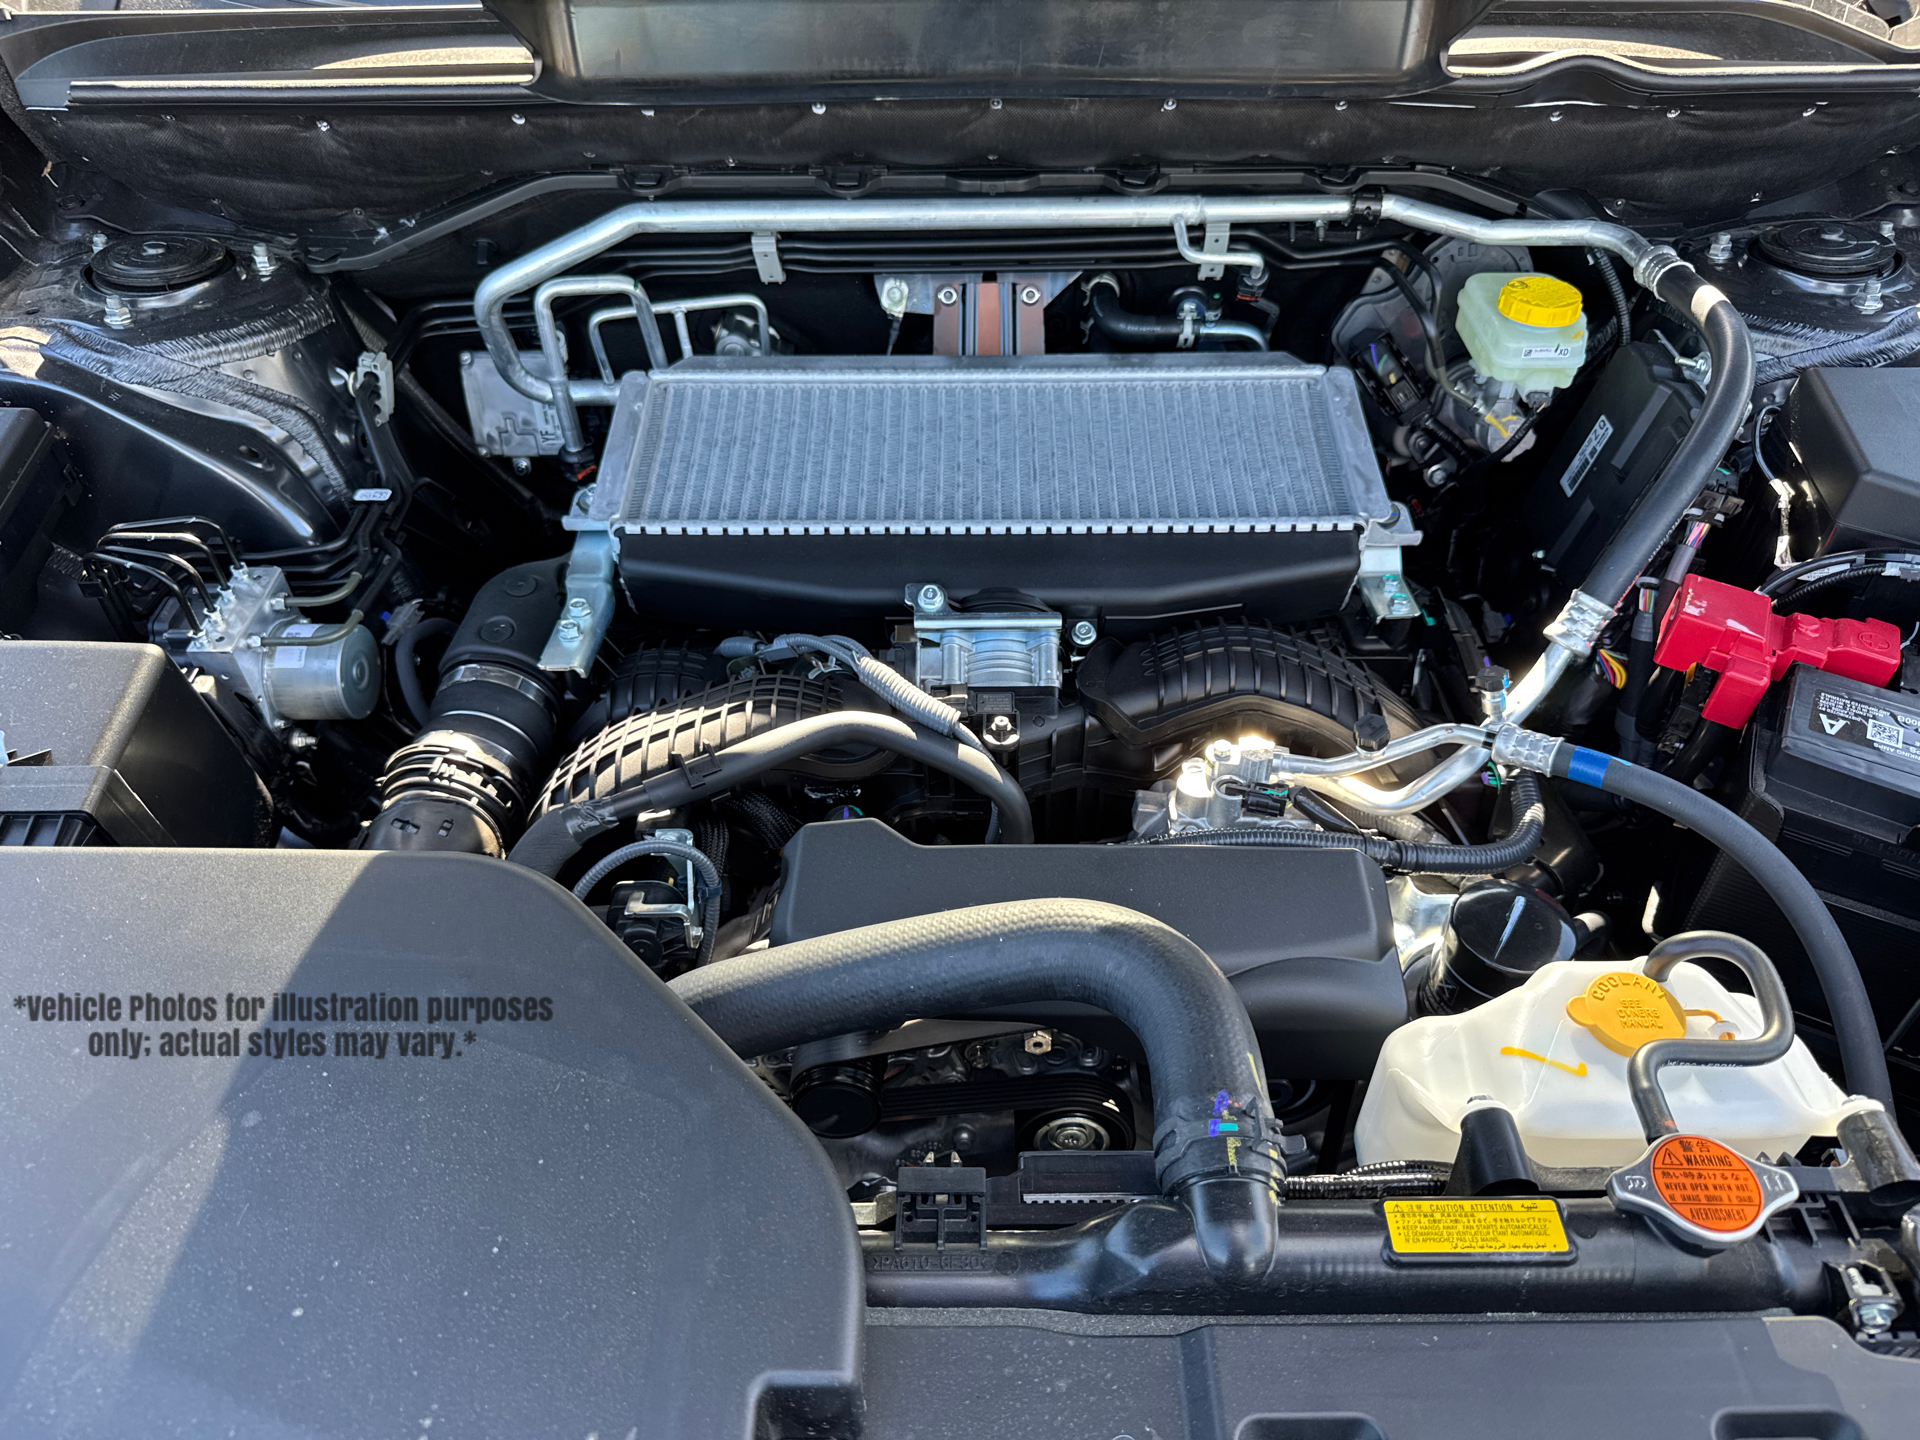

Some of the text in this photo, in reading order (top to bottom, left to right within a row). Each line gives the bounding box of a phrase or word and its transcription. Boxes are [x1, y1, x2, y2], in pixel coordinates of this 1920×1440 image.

[1873, 742, 1894, 752] AMPS
[1591, 975, 1668, 1001] COOLANT
[1620, 999, 1642, 1009] SEE
[1620, 1018, 1664, 1029] MANUAL
[1682, 1154, 1732, 1167] WARNING
[1664, 1182, 1687, 1190] NEVER
[1690, 1182, 1709, 1191] OPEN
[1712, 1183, 1732, 1191] WHEN
[1680, 1194, 1701, 1202] JAMAIS
[1430, 1203, 1513, 1212] CAUTION ATTENTION
